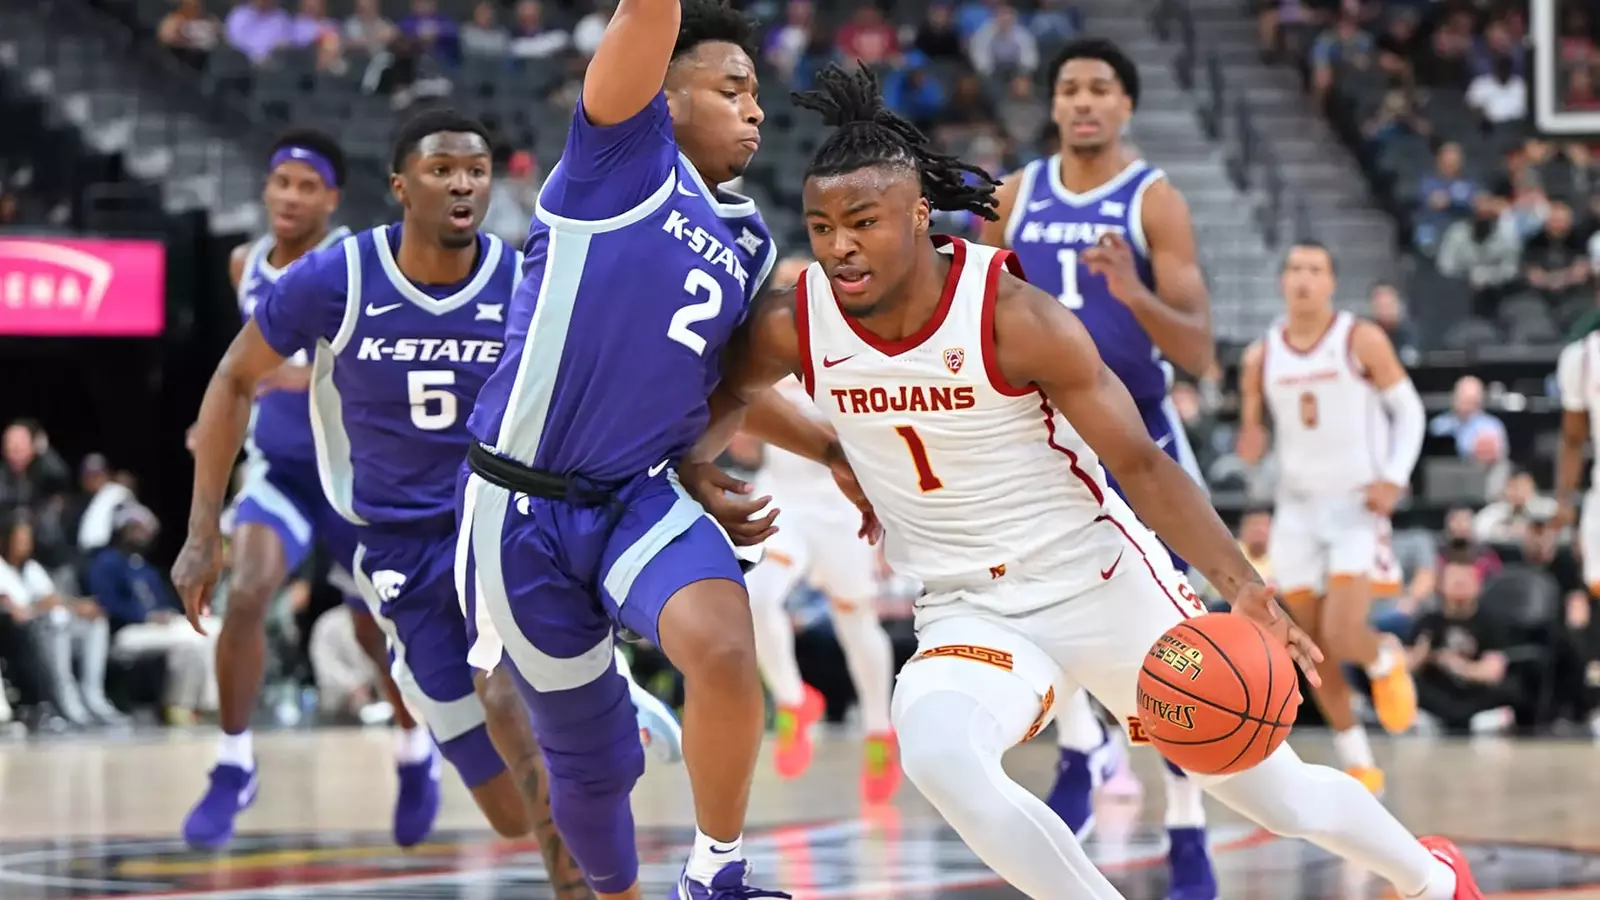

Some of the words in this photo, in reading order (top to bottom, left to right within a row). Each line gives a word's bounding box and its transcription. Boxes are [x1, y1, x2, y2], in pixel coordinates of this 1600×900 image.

[0, 270, 83, 310] ENA
[1056, 249, 1084, 310] 1
[667, 268, 723, 357] 2
[357, 337, 504, 363] K-STATE
[407, 370, 457, 430] 5
[830, 386, 976, 413] TROJANS
[893, 423, 944, 494] 1
[1136, 686, 1196, 730] SPALDI
